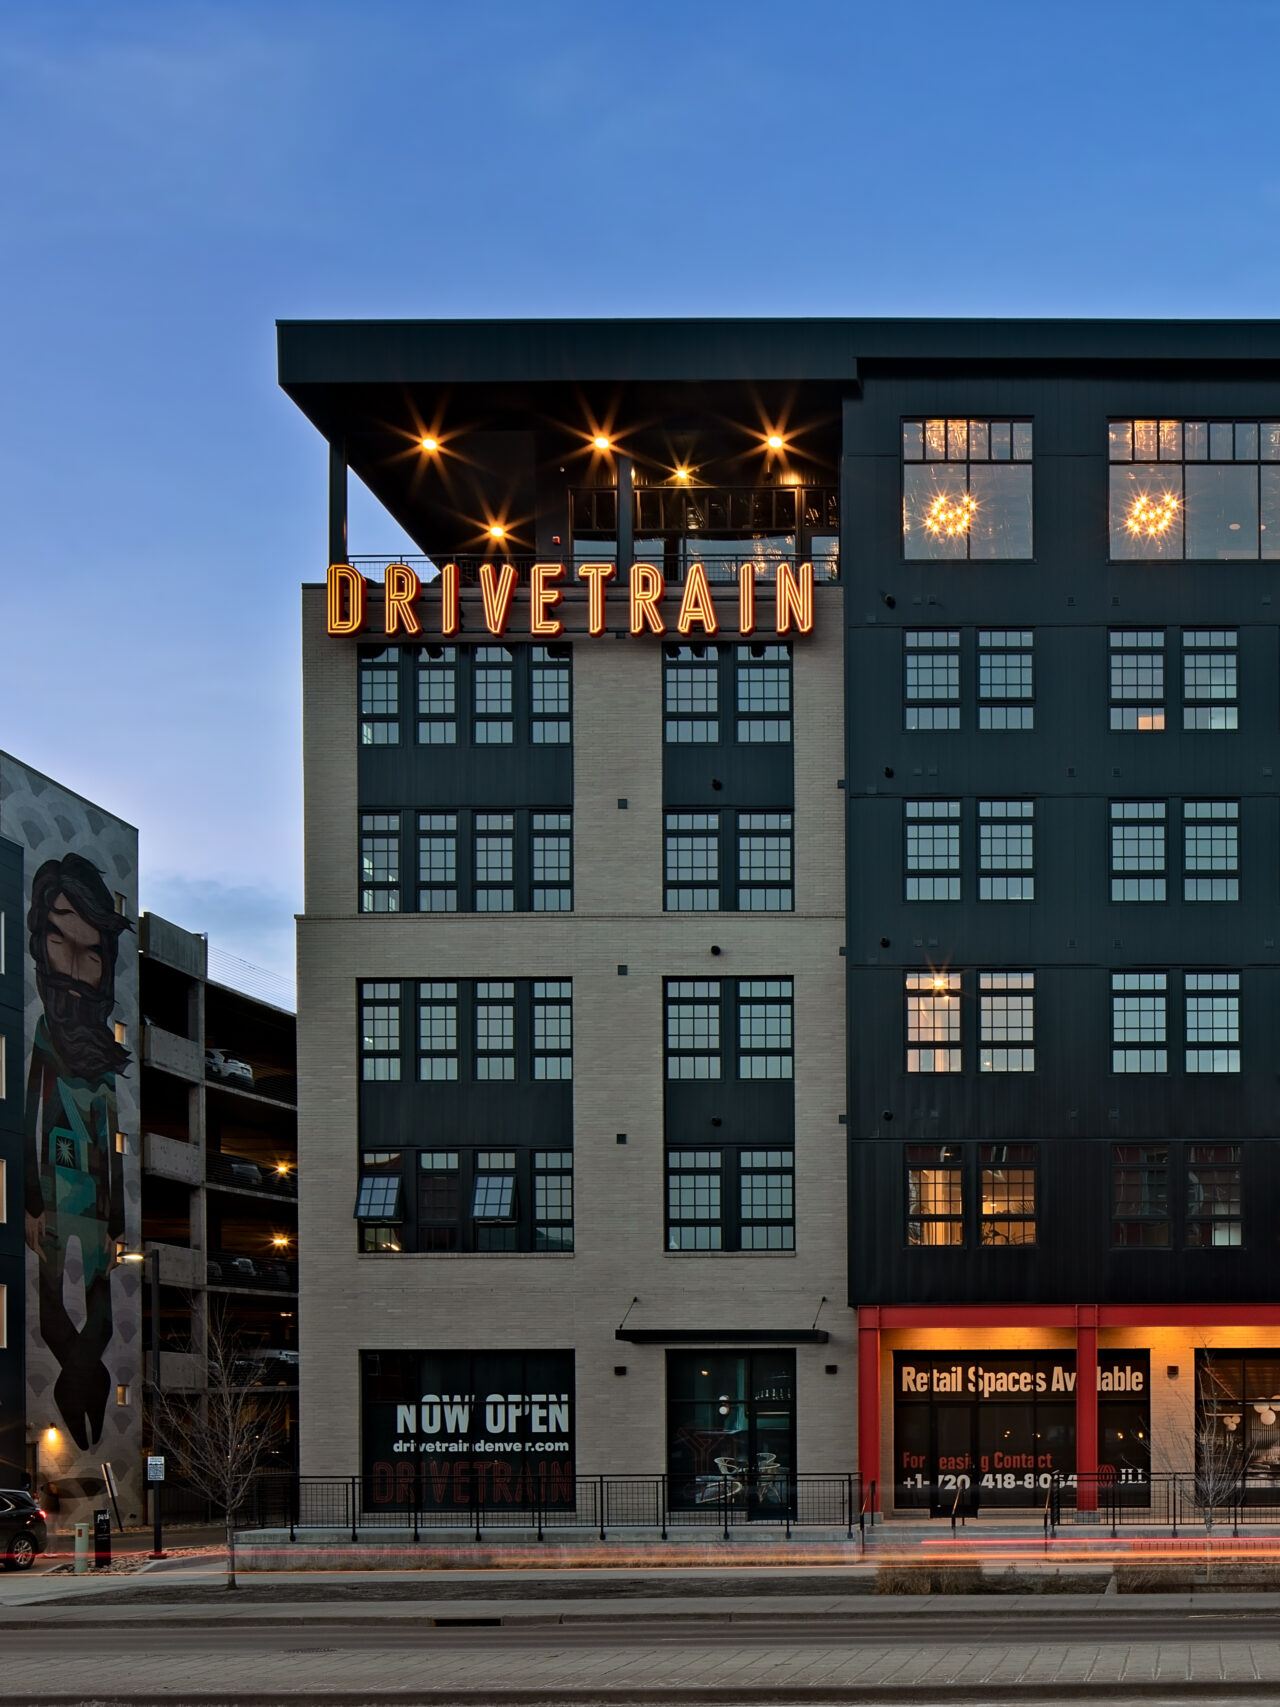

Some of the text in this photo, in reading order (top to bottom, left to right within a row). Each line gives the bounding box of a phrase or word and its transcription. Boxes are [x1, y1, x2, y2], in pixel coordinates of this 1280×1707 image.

[326, 563, 815, 638] DRIVETRAIN
[902, 1366, 1144, 1398] Retail Spaces Avlable
[396, 1393, 569, 1434] NOW OPEN
[903, 1451, 1053, 1473] For easig Contact
[1117, 1468, 1148, 1485] JLL
